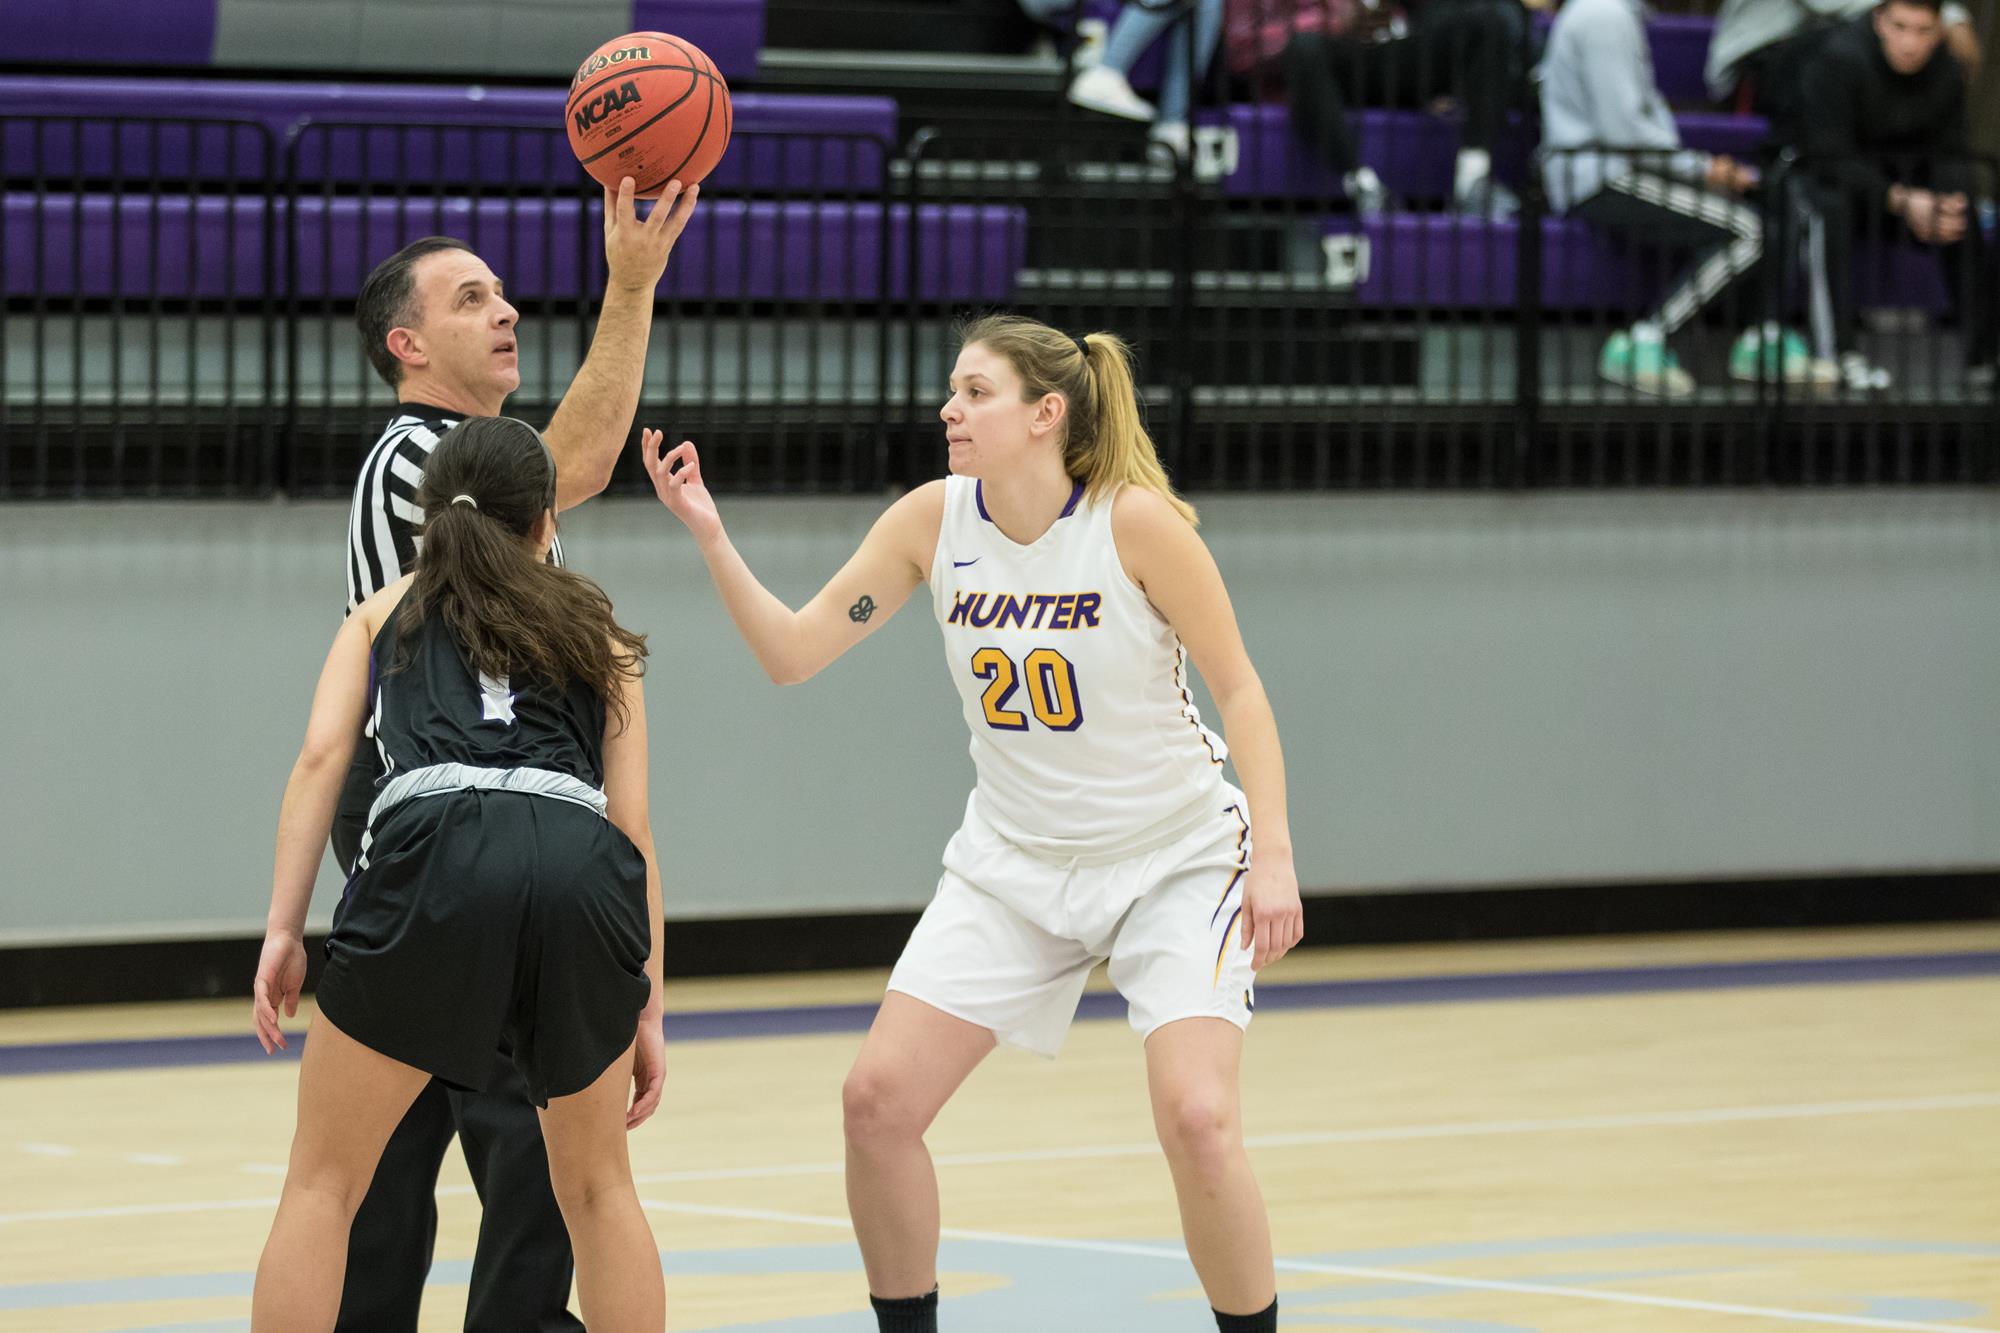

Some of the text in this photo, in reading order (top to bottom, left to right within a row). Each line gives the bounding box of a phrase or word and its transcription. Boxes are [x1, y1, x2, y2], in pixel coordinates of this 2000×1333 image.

[575, 80, 642, 137] NCAA
[948, 590, 1102, 630] HUNTER
[971, 647, 1084, 732] 20
